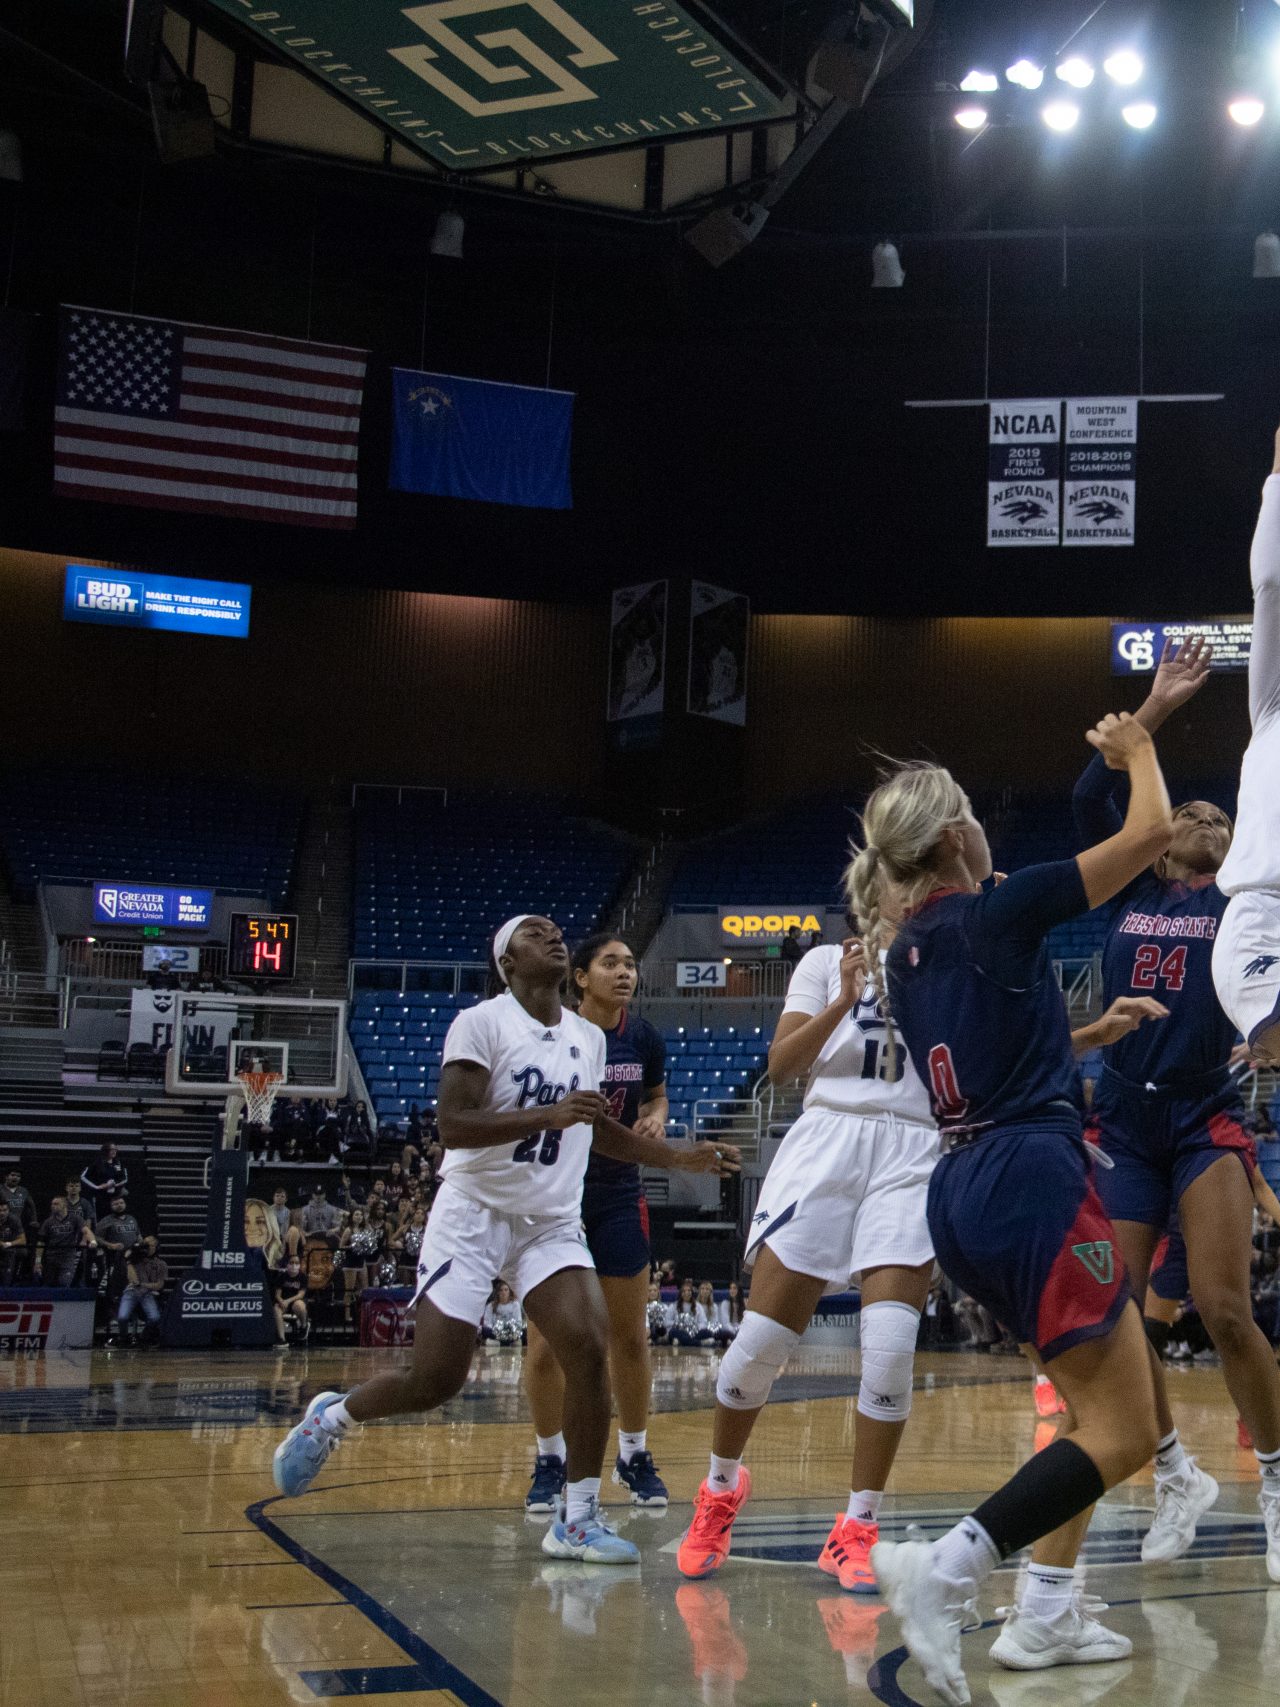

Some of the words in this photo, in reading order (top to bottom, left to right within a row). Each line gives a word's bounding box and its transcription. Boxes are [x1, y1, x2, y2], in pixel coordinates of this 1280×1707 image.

[249, 11, 444, 138] BLOCKCHAINS
[486, 106, 722, 155] BLOCKCHAINS
[1076, 406, 1127, 415] MOUNTAIN
[993, 415, 1057, 435] NCAA
[1088, 418, 1115, 427] WEST
[1069, 429, 1133, 438] CONFERENCE
[1008, 448, 1041, 458] 2019
[1069, 452, 1132, 461] 2018-2019
[1008, 458, 1041, 467] FIRST
[1070, 463, 1131, 472] CHAMPIONS
[1004, 467, 1045, 476] ROUND
[993, 485, 1055, 505] NEVADA
[1068, 485, 1130, 505] NEVADA
[991, 528, 1057, 538] BASKETBALL
[1066, 529, 1131, 538] BASKETBALL
[87, 580, 131, 599] BUD
[77, 593, 138, 613] LIGHT
[145, 591, 174, 602] MAKE
[174, 594, 191, 603] THE
[191, 595, 220, 606] RIGHT
[220, 599, 242, 608] CALL
[145, 603, 175, 613] DRINK
[176, 606, 242, 620] RESPONSIBLY
[1162, 624, 1221, 636] COLDWELL
[1204, 635, 1227, 645] REAL
[119, 891, 164, 904] GREATER
[179, 896, 192, 904] GO
[119, 901, 164, 913] NEVADA
[179, 904, 205, 913] WOLF
[118, 911, 140, 919] Credit
[142, 912, 164, 920] Union
[178, 913, 206, 922] PACK!
[1119, 911, 1171, 936] FRESNO
[1169, 915, 1216, 940] STATE
[254, 941, 282, 971] 14
[1131, 944, 1188, 990] 24
[685, 965, 719, 984] 34
[226, 1176, 234, 1196] BANK
[223, 1220, 232, 1249] NEVADA
[214, 1252, 245, 1264] NSB
[205, 1282, 264, 1291] LEXUS
[182, 1301, 224, 1312] DOLAN
[227, 1301, 263, 1311] LEXUS
[826, 1313, 857, 1327] STATE
[15, 1337, 41, 1348] FM
